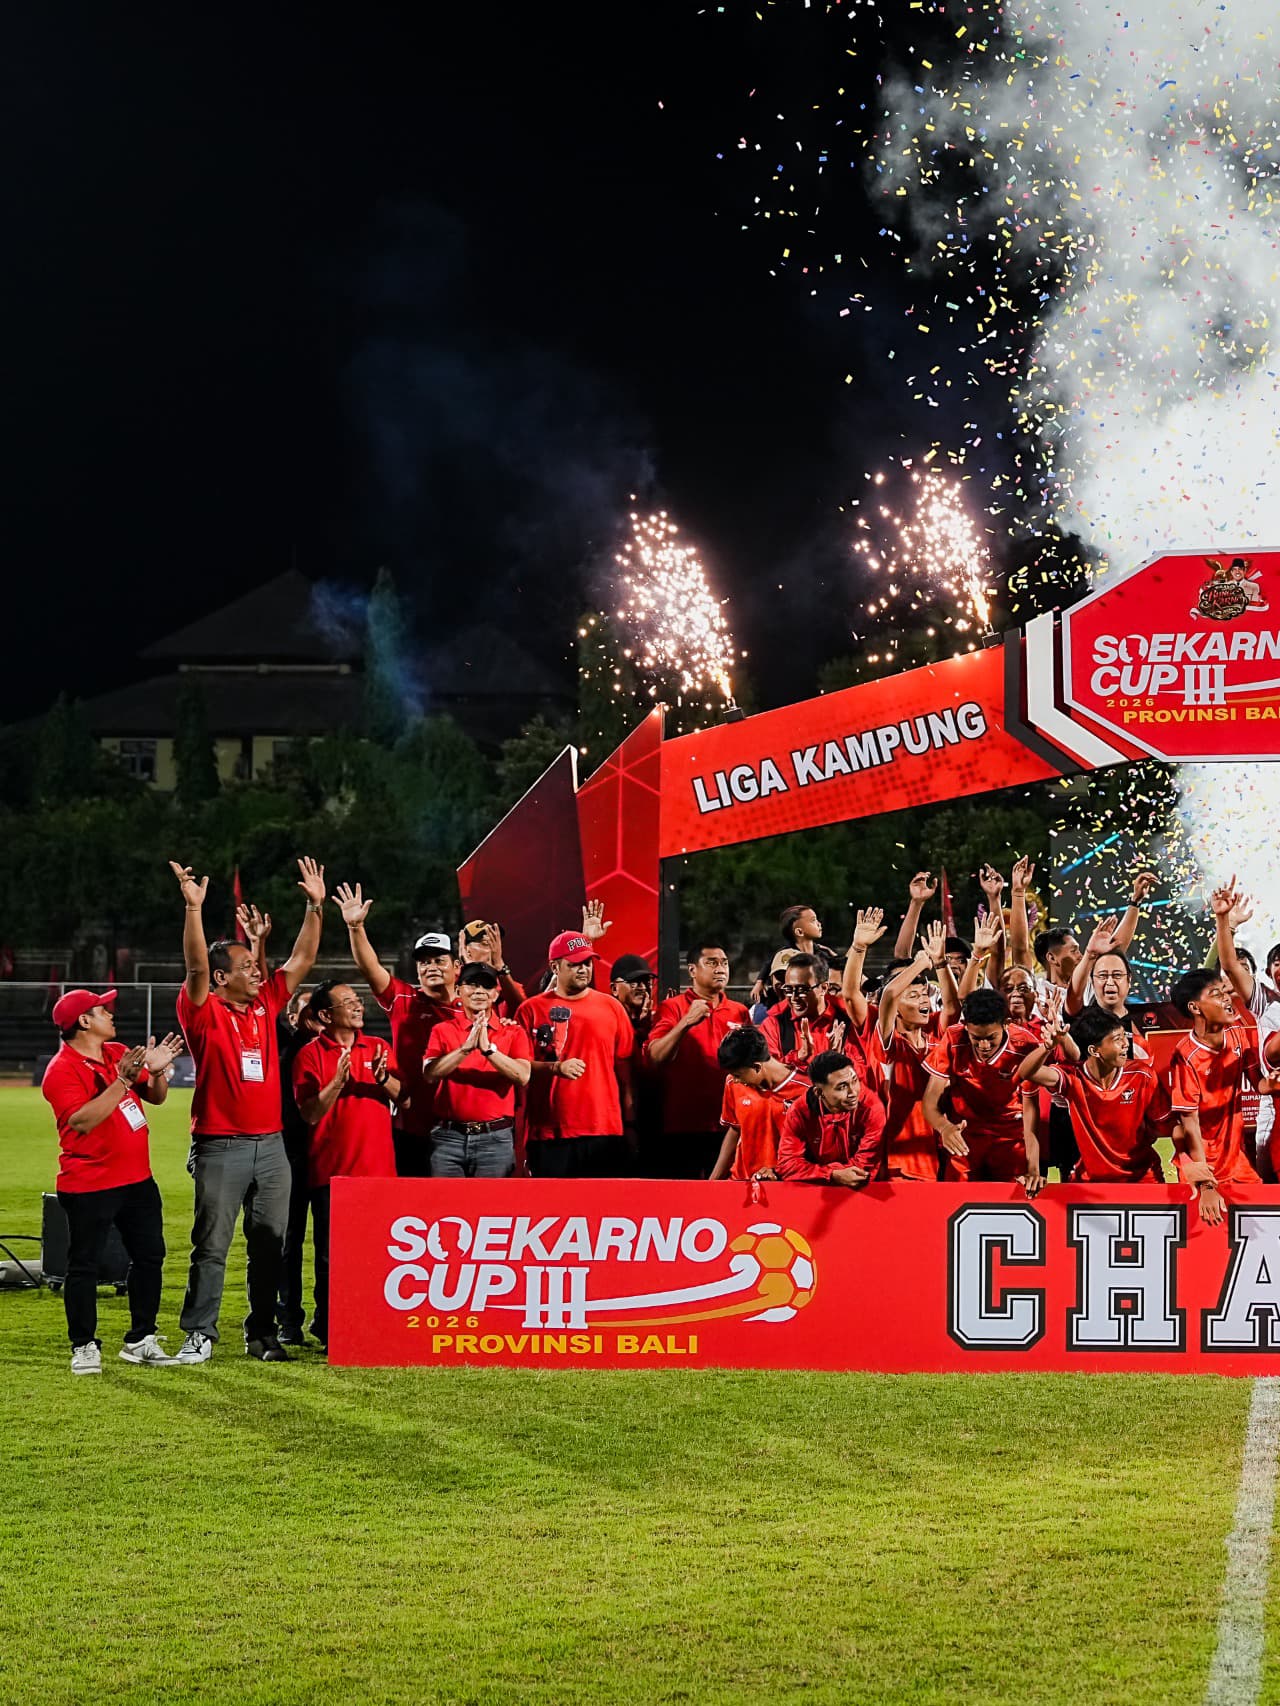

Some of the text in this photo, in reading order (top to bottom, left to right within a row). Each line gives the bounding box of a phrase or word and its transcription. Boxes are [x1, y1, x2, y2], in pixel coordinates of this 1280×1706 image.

[1090, 664, 1227, 705] CUP III
[1106, 698, 1154, 707] 2026
[1123, 707, 1237, 723] PROVINSI
[692, 702, 987, 814] LIGA KAMPUNG
[387, 1216, 728, 1262] SOEKARNO
[383, 1264, 590, 1329] CUP III
[407, 1315, 480, 1328] 2026
[432, 1335, 698, 1354] PROVINSI BALI
